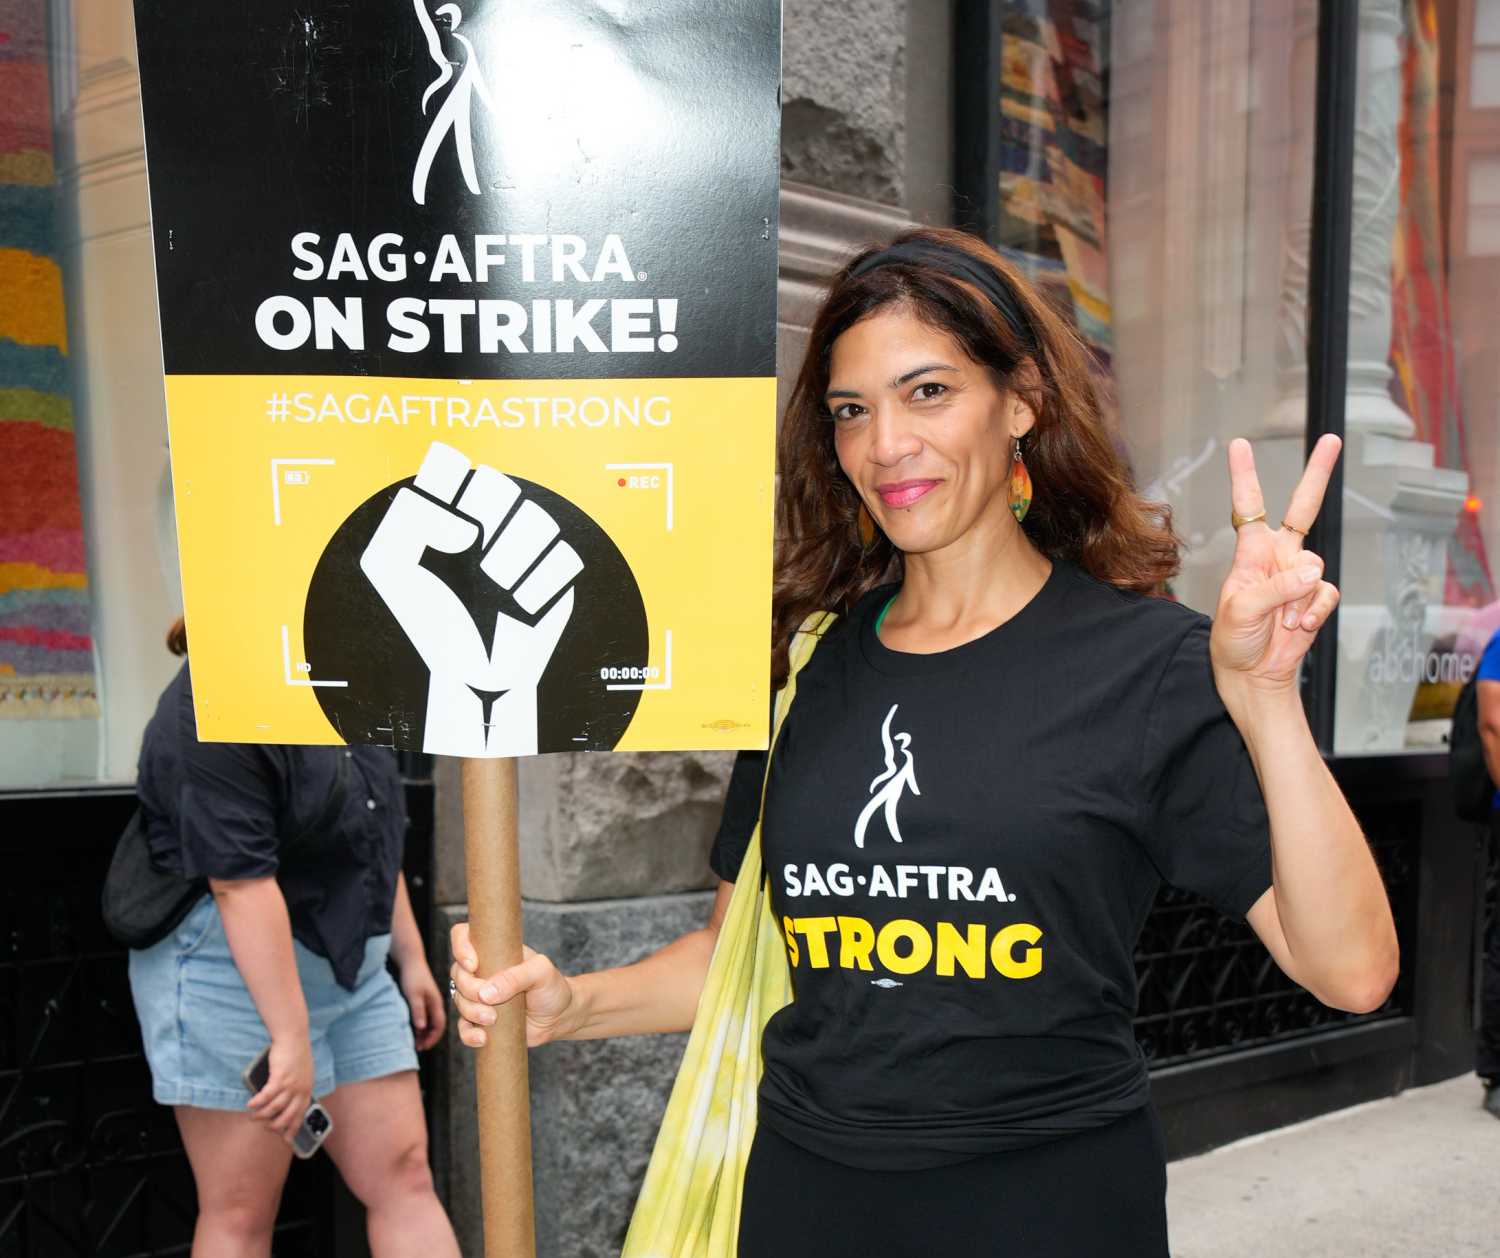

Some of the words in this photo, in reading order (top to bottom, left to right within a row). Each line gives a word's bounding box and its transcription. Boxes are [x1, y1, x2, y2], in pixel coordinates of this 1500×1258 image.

[255, 295, 364, 351] ON
[386, 297, 679, 353] STRIKE!
[266, 392, 672, 428] #SAGAFTRASTRONG
[629, 475, 660, 489] REC
[600, 666, 659, 680] 00:00:00
[783, 914, 1043, 980] STRONG
